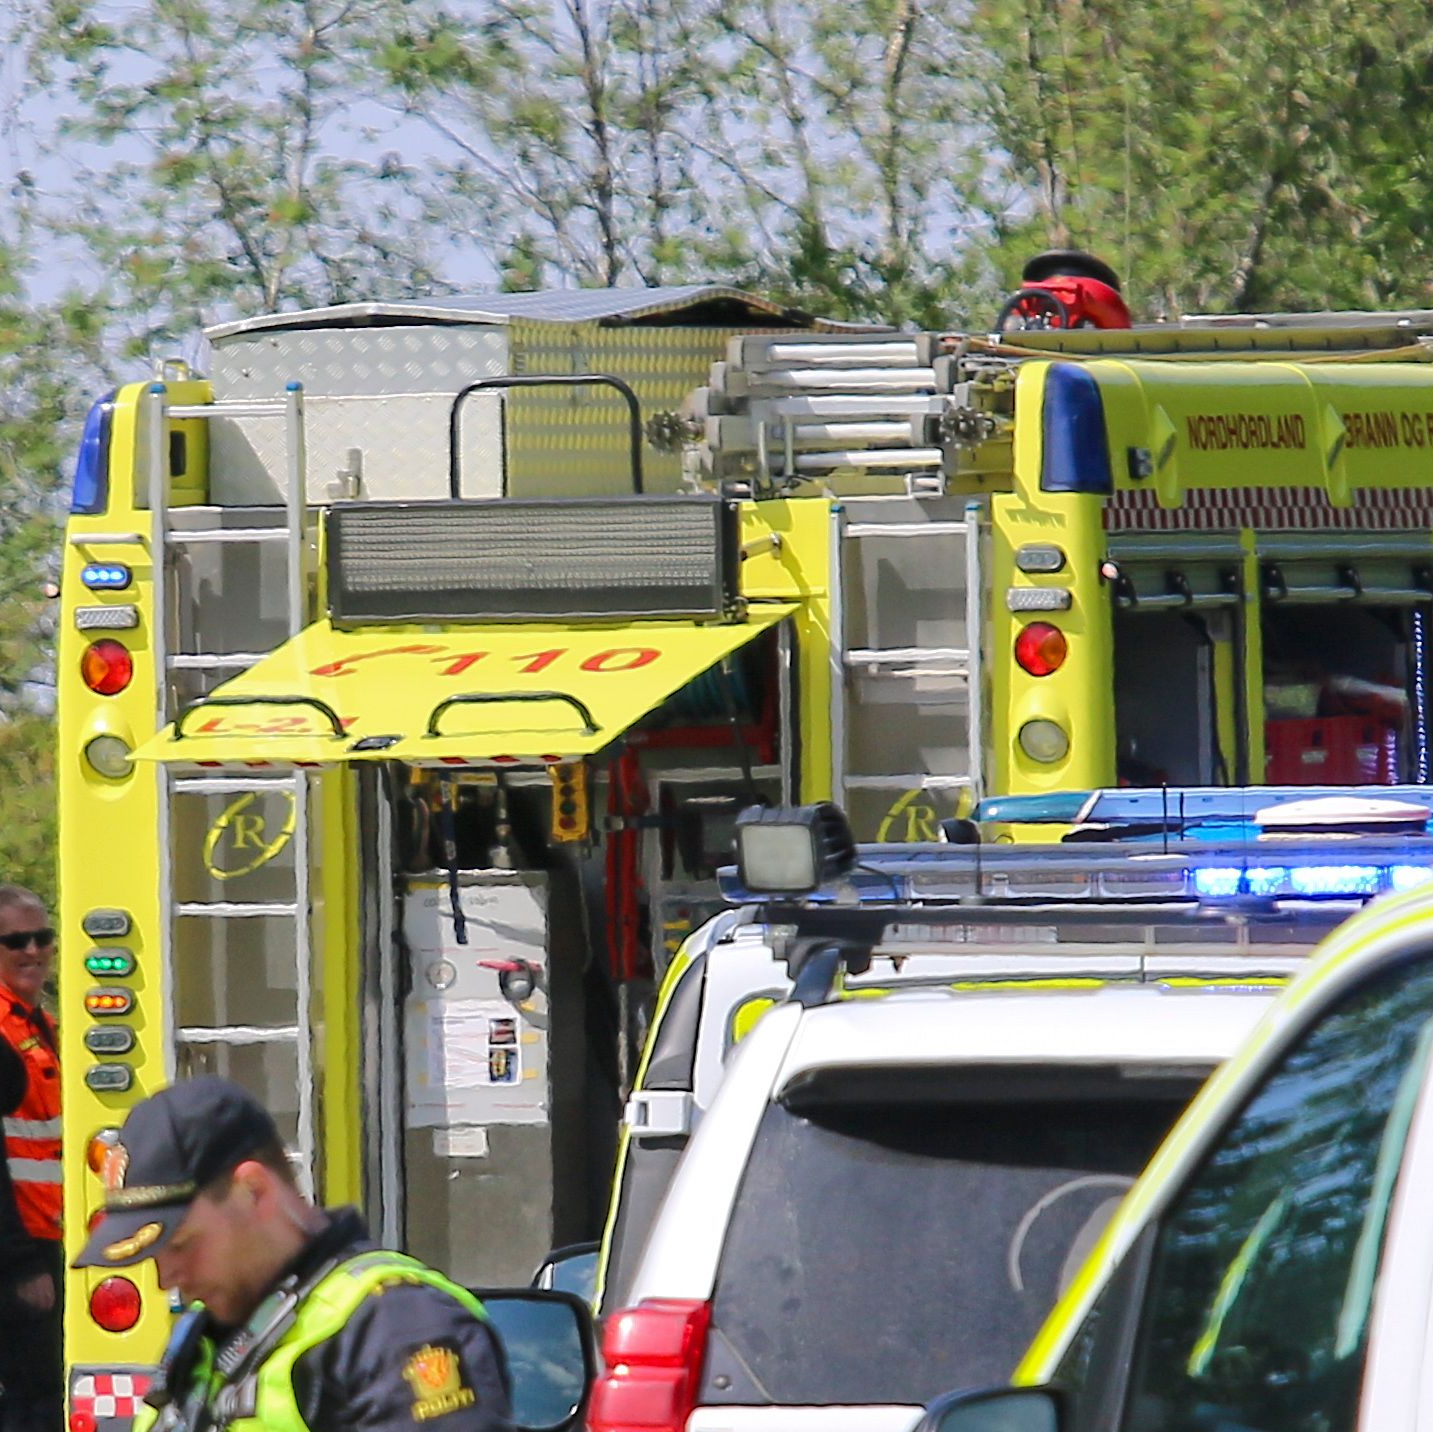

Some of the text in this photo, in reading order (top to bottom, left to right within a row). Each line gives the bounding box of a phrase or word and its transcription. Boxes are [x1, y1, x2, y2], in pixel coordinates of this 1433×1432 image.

[1186, 413, 1306, 450] NORDHORDLAND
[1342, 411, 1399, 449] BRANN
[1400, 411, 1425, 448] OG
[430, 648, 662, 676] 110
